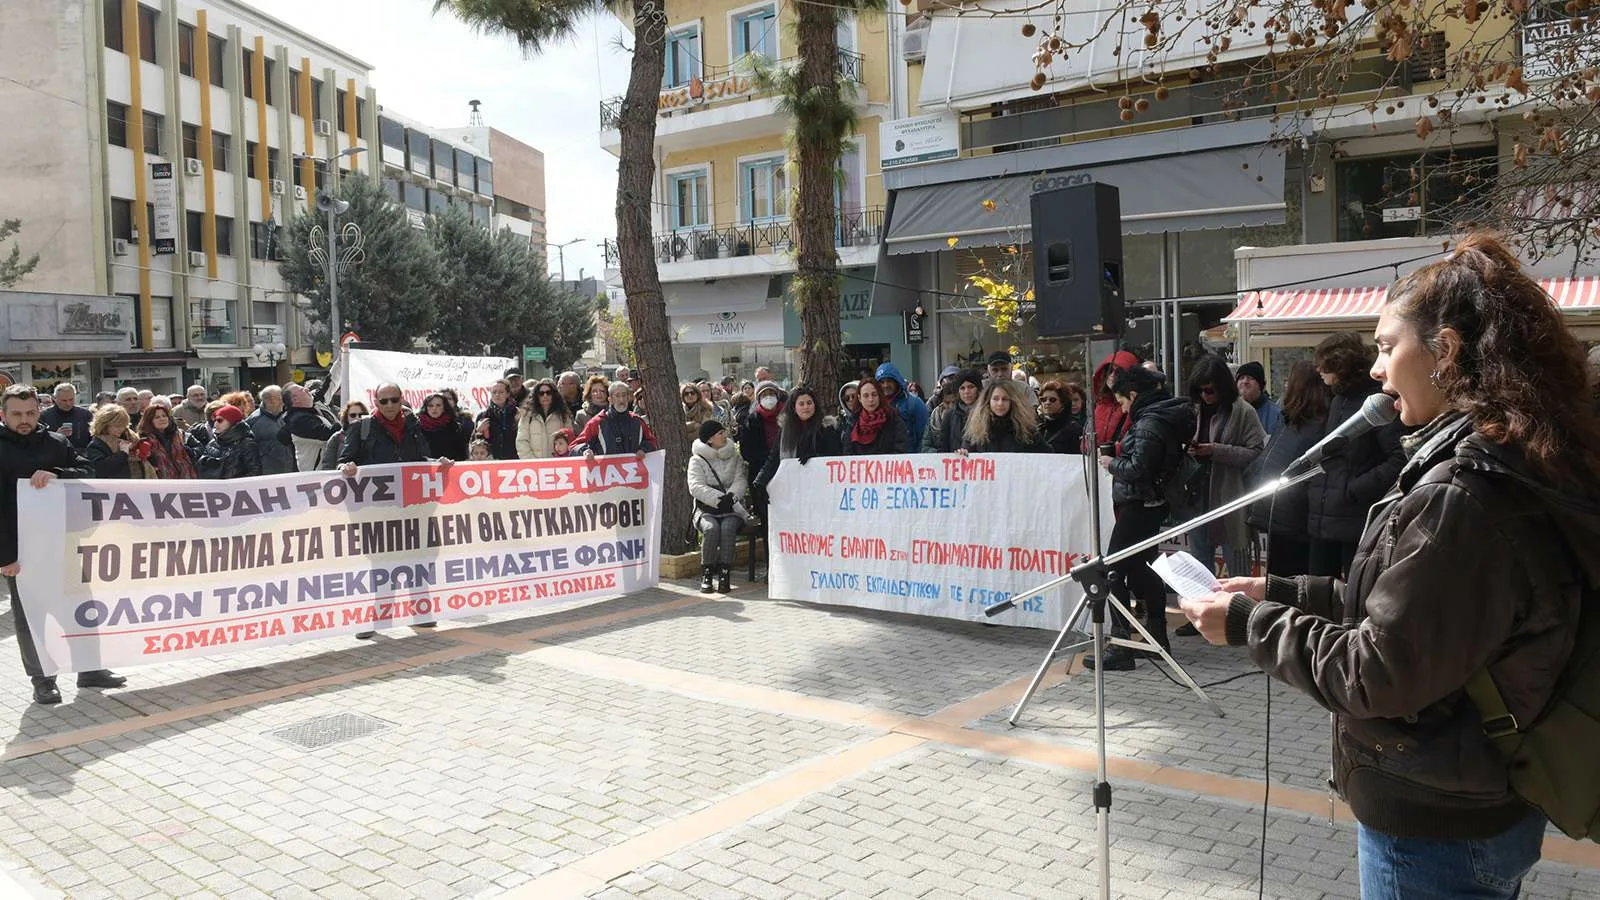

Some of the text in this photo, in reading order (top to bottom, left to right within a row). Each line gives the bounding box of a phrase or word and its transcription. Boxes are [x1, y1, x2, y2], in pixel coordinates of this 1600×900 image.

[707, 321, 746, 335] TAMMY
[81, 491, 144, 522] ΤΑ
[149, 486, 291, 519] ΚΕΡΔΗ
[297, 475, 395, 507] ΤΟΥΣ
[459, 469, 491, 496] ΟΙ
[497, 466, 574, 494] ΖΩΕΣ
[579, 462, 643, 489] ΜΑΣ
[826, 460, 846, 483] ΤΟ
[851, 459, 915, 484] ΕΓΚΛΗΜΑ
[942, 458, 995, 481] ΤΕΜΠΗ
[840, 487, 856, 511] ΔΕ
[862, 487, 878, 510] ΘΑ
[77, 498, 645, 584] ΤΟ ΕΓΚΛΗΜΑ ΣΤΑ ΤΕΜΠΗ ΔΕΝ ΘΑ ΣΥΓΚΑΛΥΦΘΕΙ
[779, 531, 835, 557] ΠΑΛΕΥΟΥΜΕ
[841, 536, 887, 560] ΕΝΑΝΤΙΑ
[912, 539, 1003, 570] ΕΓΚΛΗΜΑΤΙΚΗ
[74, 537, 645, 628] ΟΛΩΝ ΤΩΝ ΝΕΚΡΩΝ ΕΙΜΑΣΤΕ ΦΩΝΗ
[143, 573, 616, 655] ΣΩΜΑΤΕΙΑ ΚΑΙ ΜΑΖΙΚΟΙ ΦΟΡΕΙΣ Ν.ΙΩΝΙΑΣ
